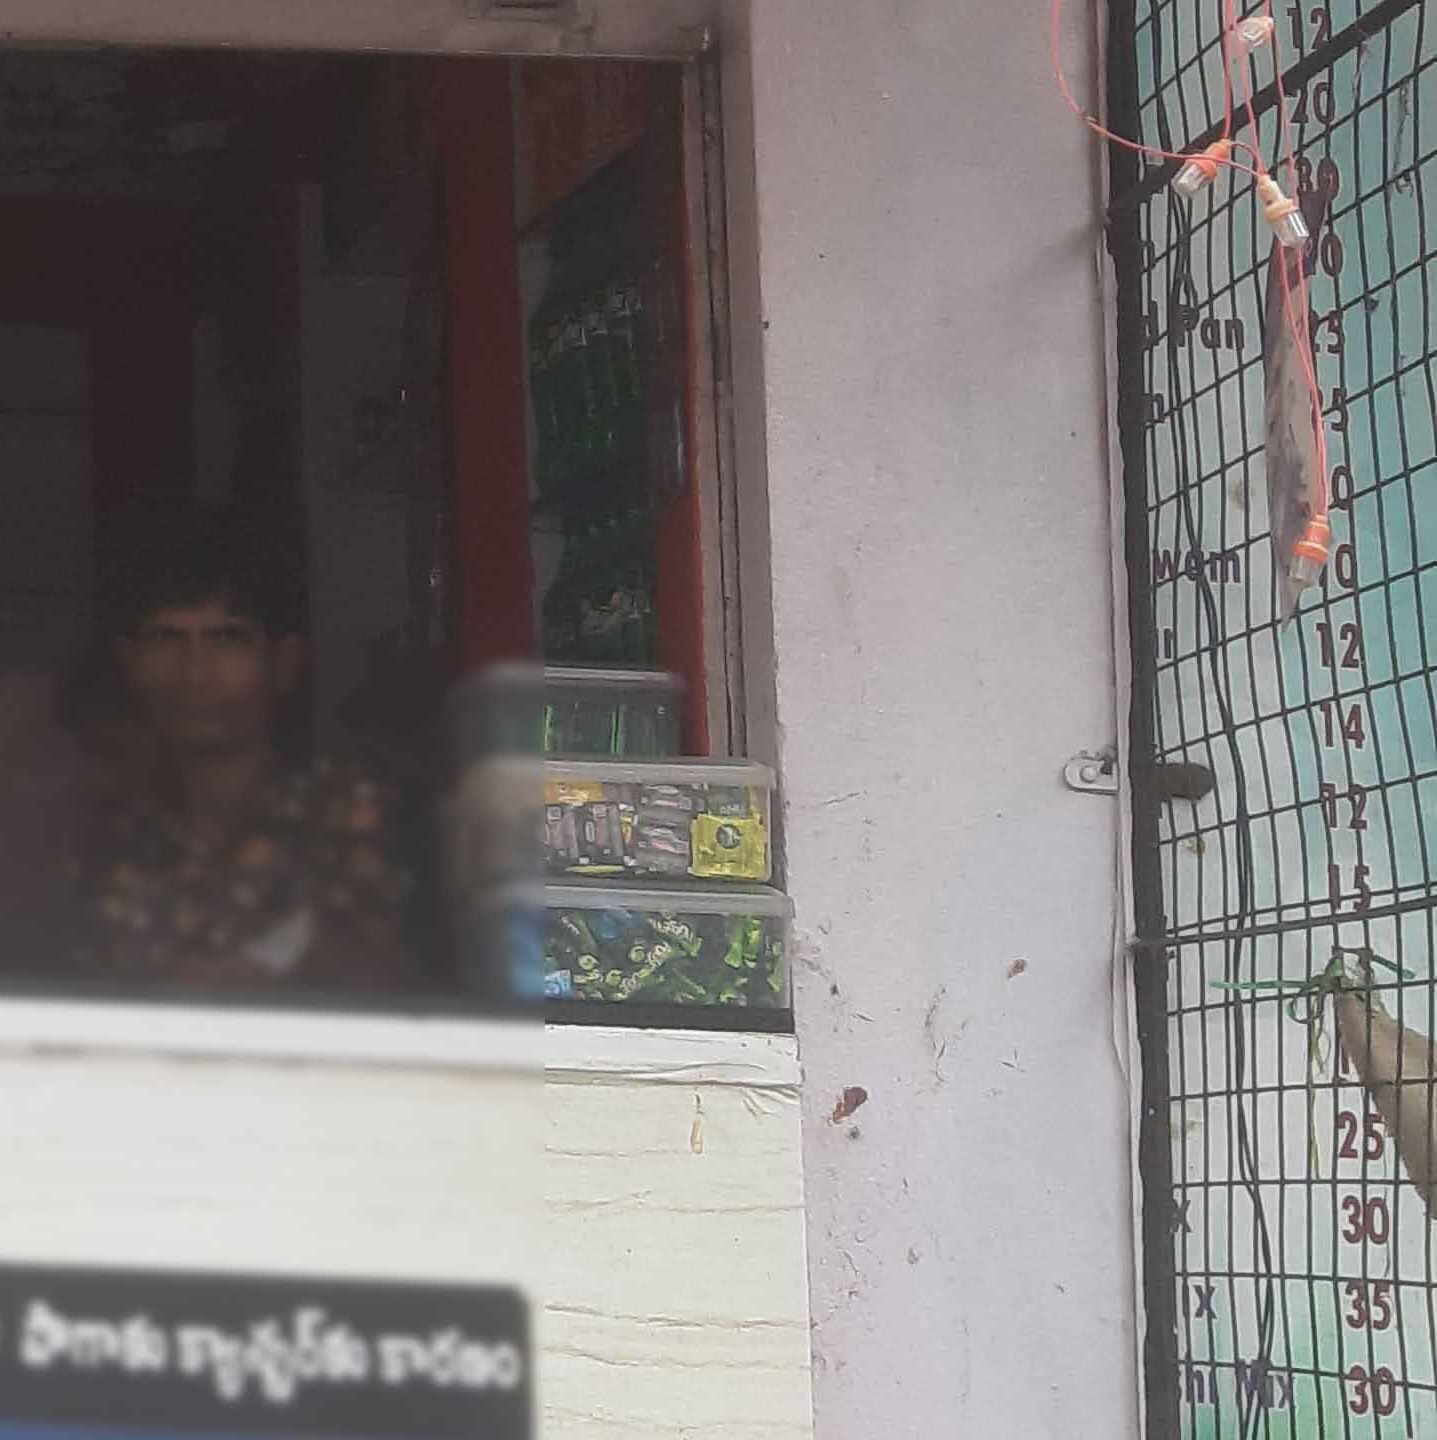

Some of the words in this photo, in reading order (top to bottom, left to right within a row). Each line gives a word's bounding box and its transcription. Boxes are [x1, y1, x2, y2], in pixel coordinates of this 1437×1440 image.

[1287, 7, 1331, 51] 12
[1316, 622, 1362, 669] 12
[1319, 703, 1366, 749] 14
[1323, 782, 1369, 830] 12
[1328, 863, 1371, 913] 15
[1336, 1110, 1385, 1161] 25
[1341, 1195, 1390, 1245] 30
[1345, 1278, 1392, 1331] 35
[1348, 1364, 1397, 1417] 30
